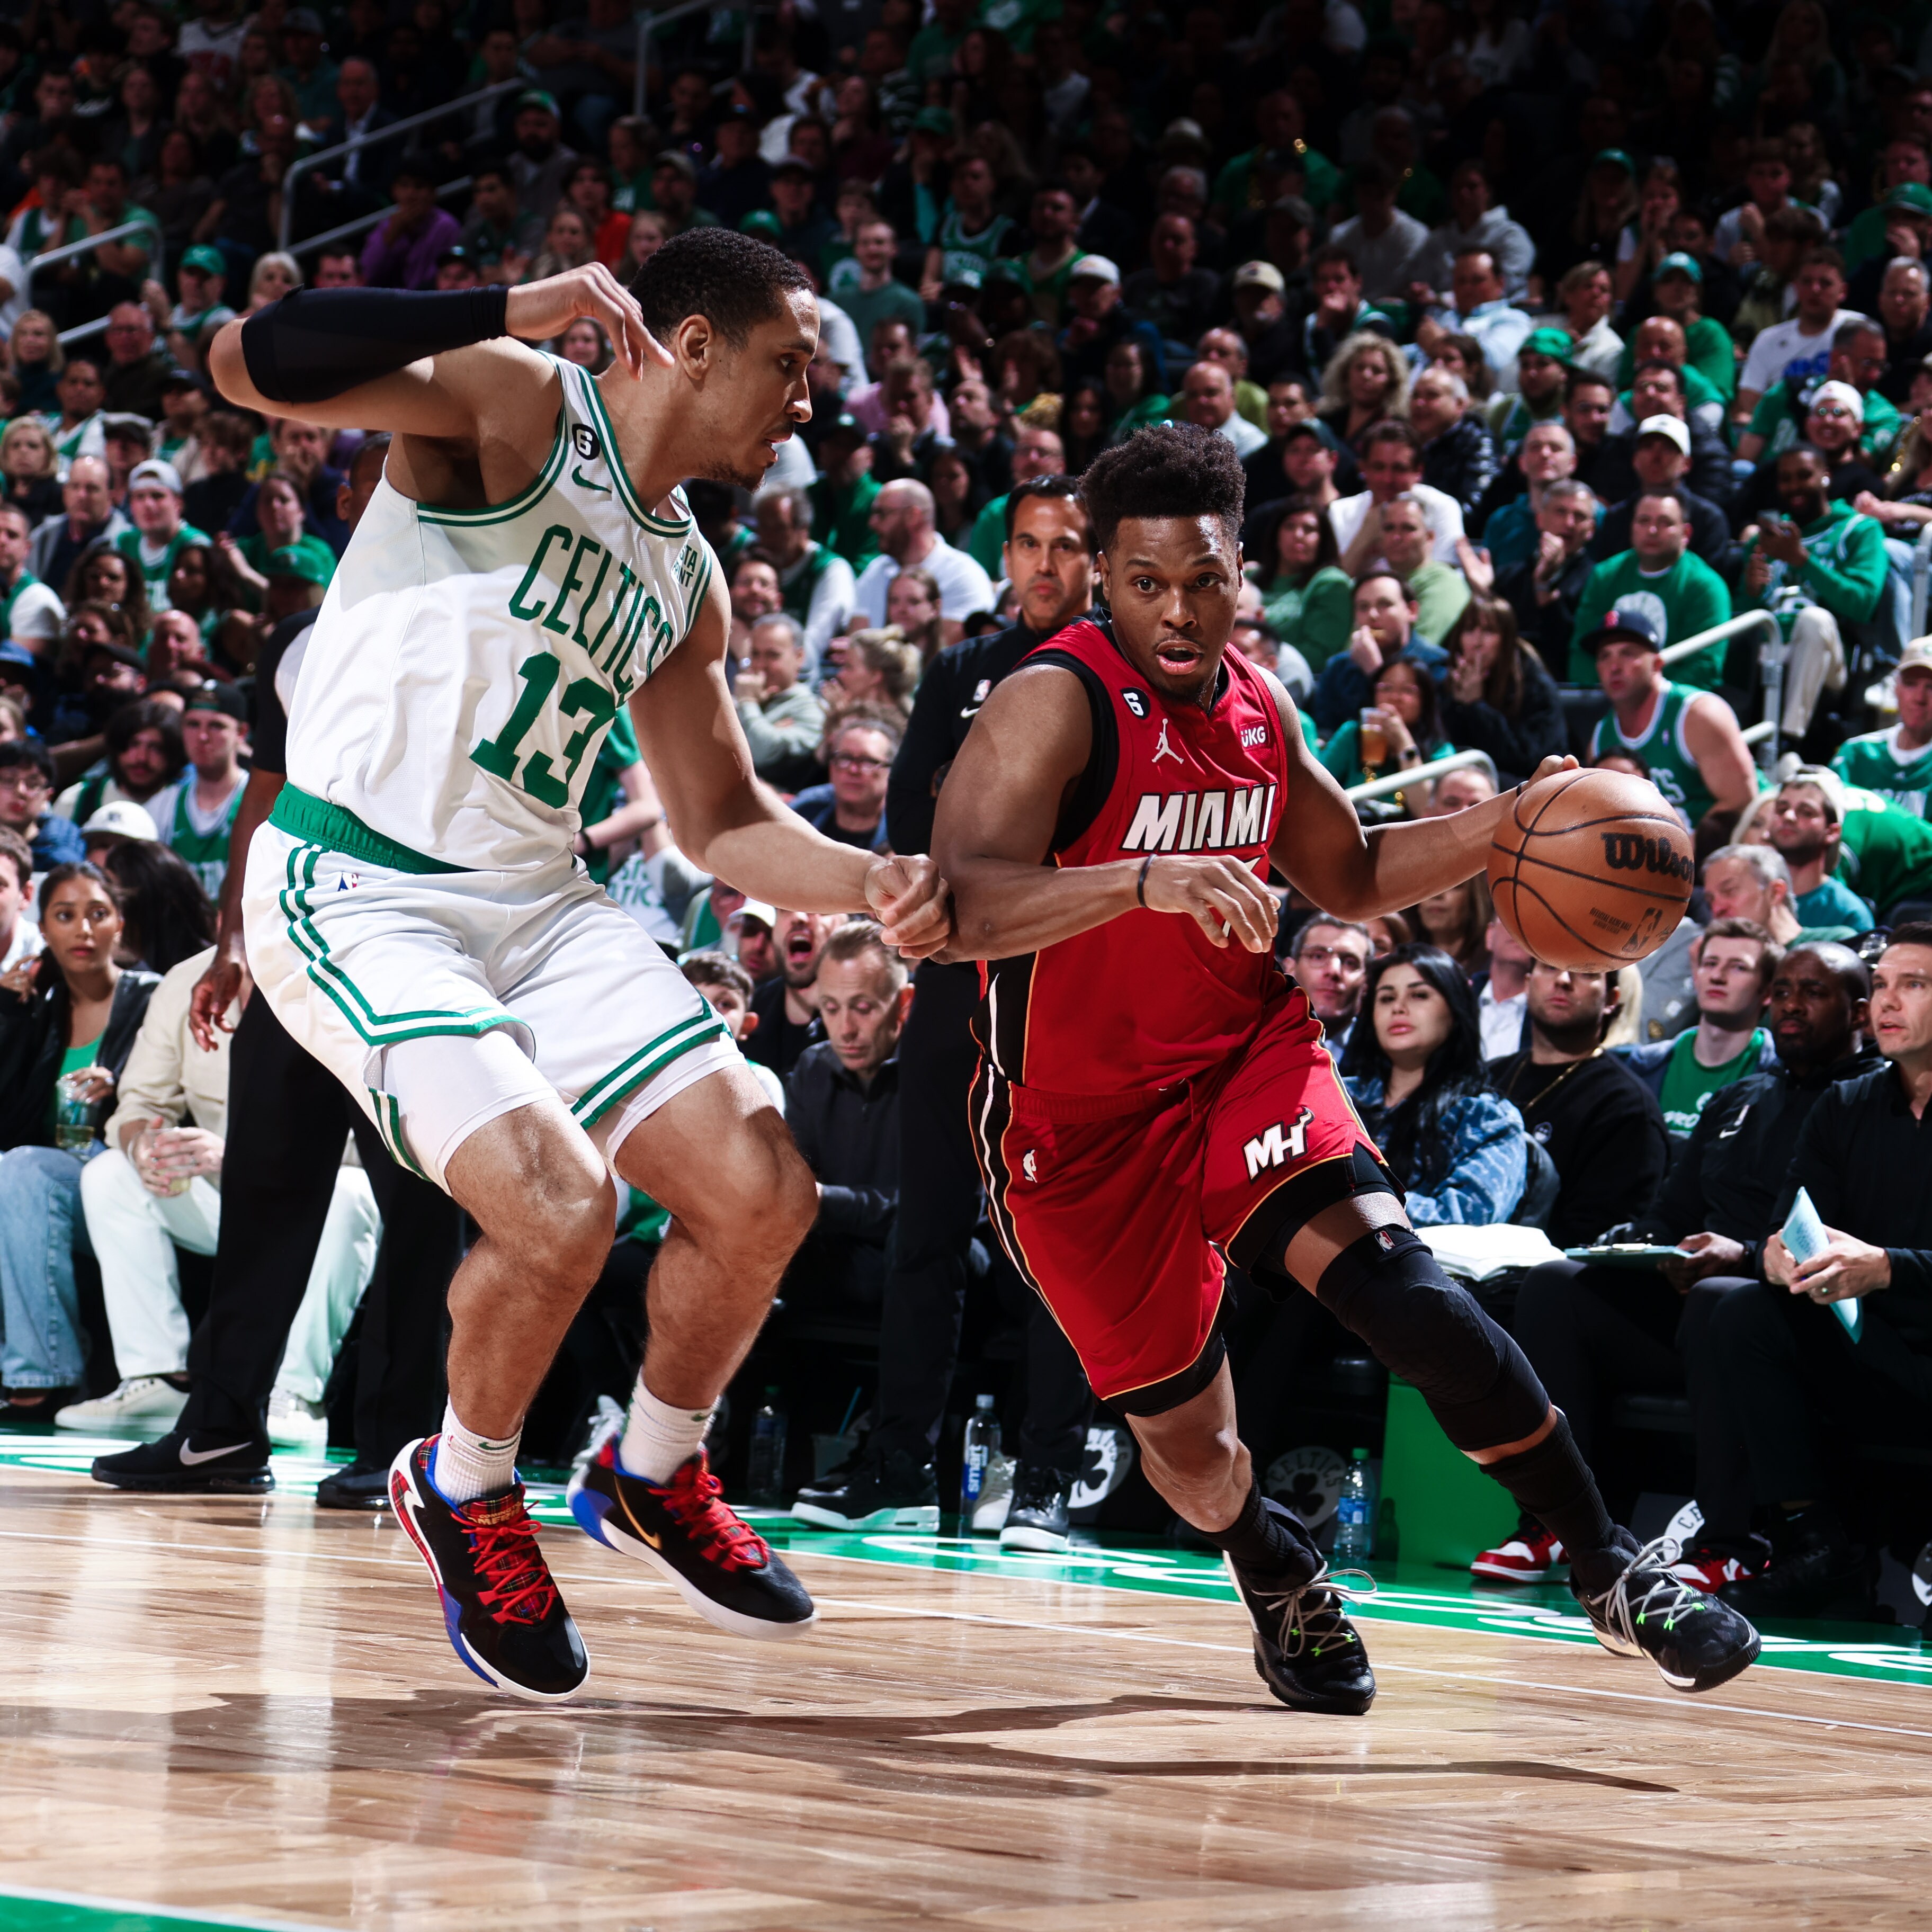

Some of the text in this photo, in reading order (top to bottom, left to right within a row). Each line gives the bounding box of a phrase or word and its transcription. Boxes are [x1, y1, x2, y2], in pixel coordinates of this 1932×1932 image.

[576, 428, 593, 456] 6
[680, 544, 698, 574] STA
[1123, 692, 1144, 716] 6
[469, 651, 616, 809] 13
[1119, 782, 1278, 852] MIAMI
[1087, 1427, 1129, 1462] TICS
[1269, 1451, 1344, 1488] CELTICS
